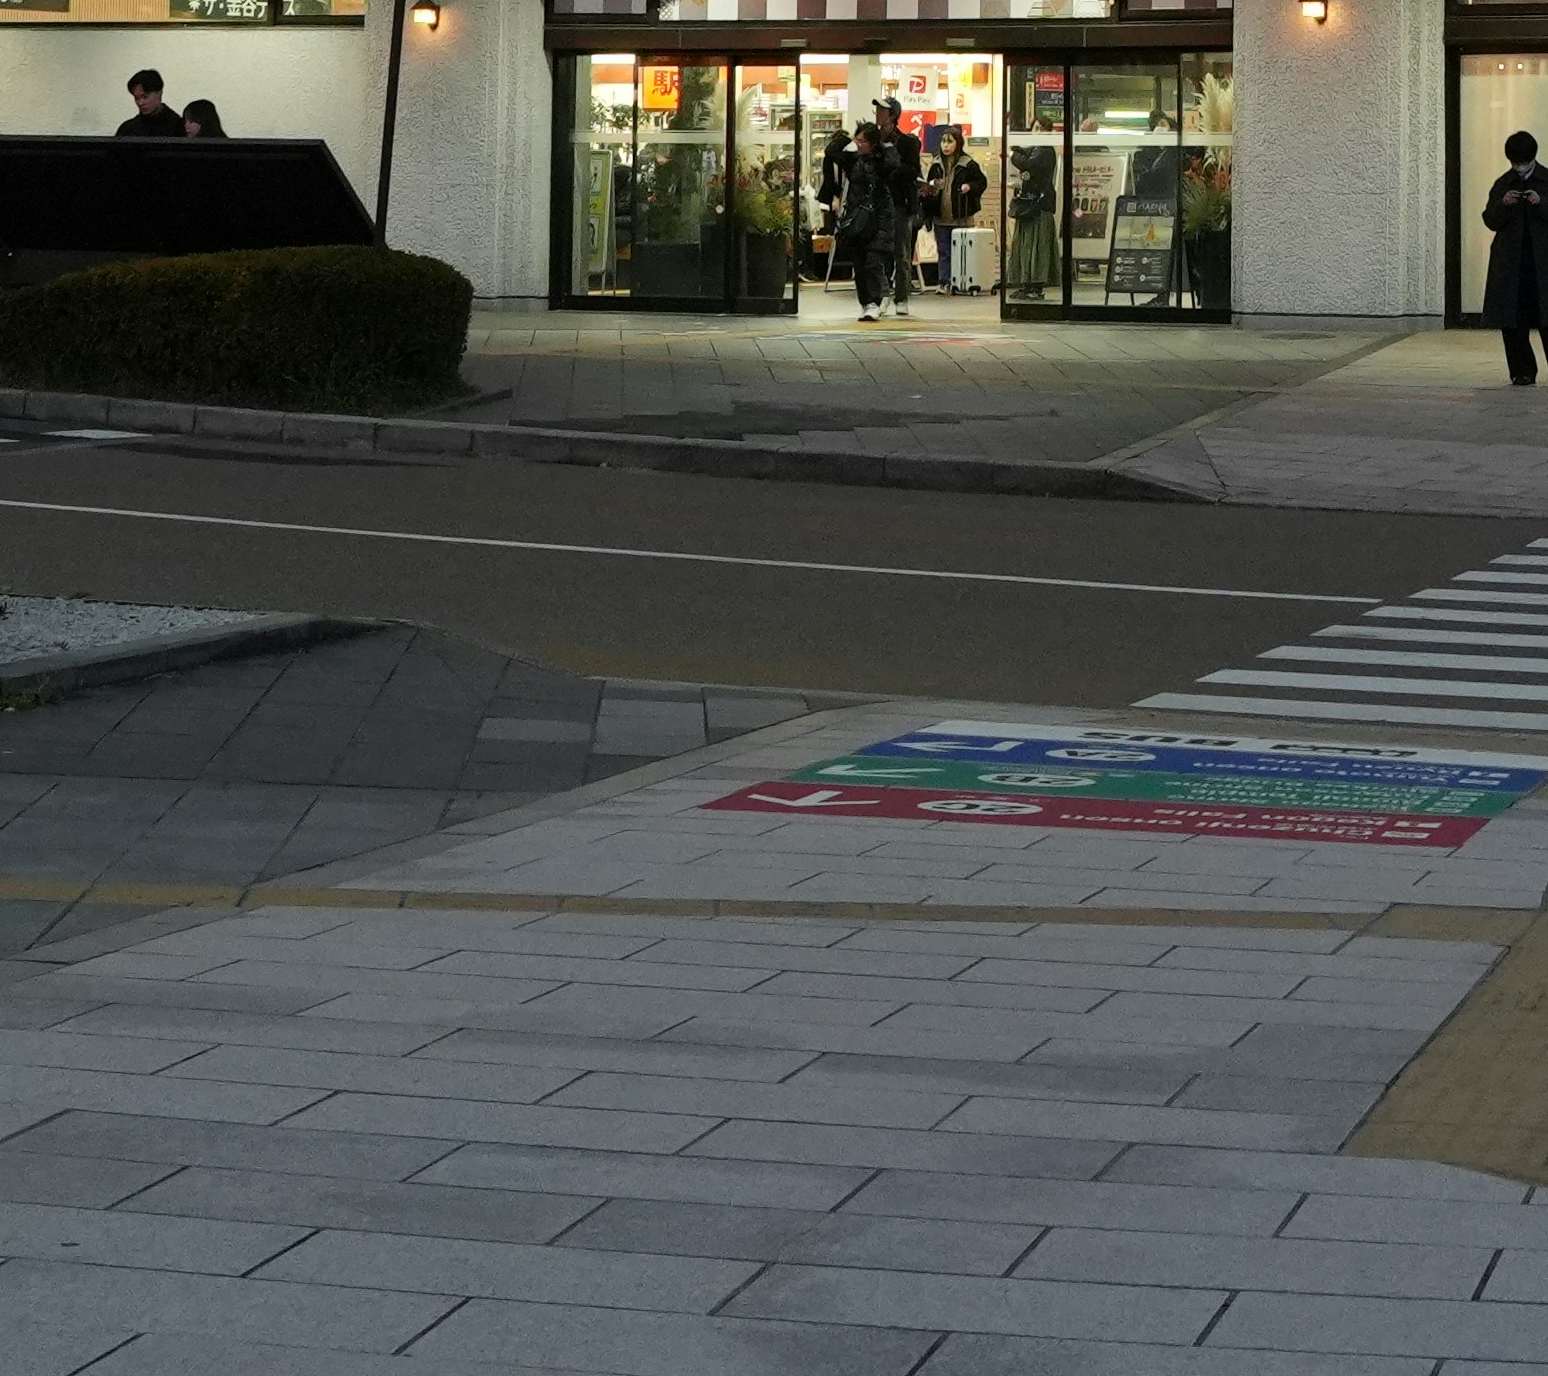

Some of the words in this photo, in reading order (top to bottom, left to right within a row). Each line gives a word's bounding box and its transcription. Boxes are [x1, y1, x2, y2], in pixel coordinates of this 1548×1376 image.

[1071, 731, 1241, 746] BUS
[1054, 750, 1133, 759] 2A
[986, 774, 1084, 785] 2B
[927, 801, 1029, 813] 2C
[1148, 808, 1250, 818] Falls
[1058, 814, 1185, 824] onsen
